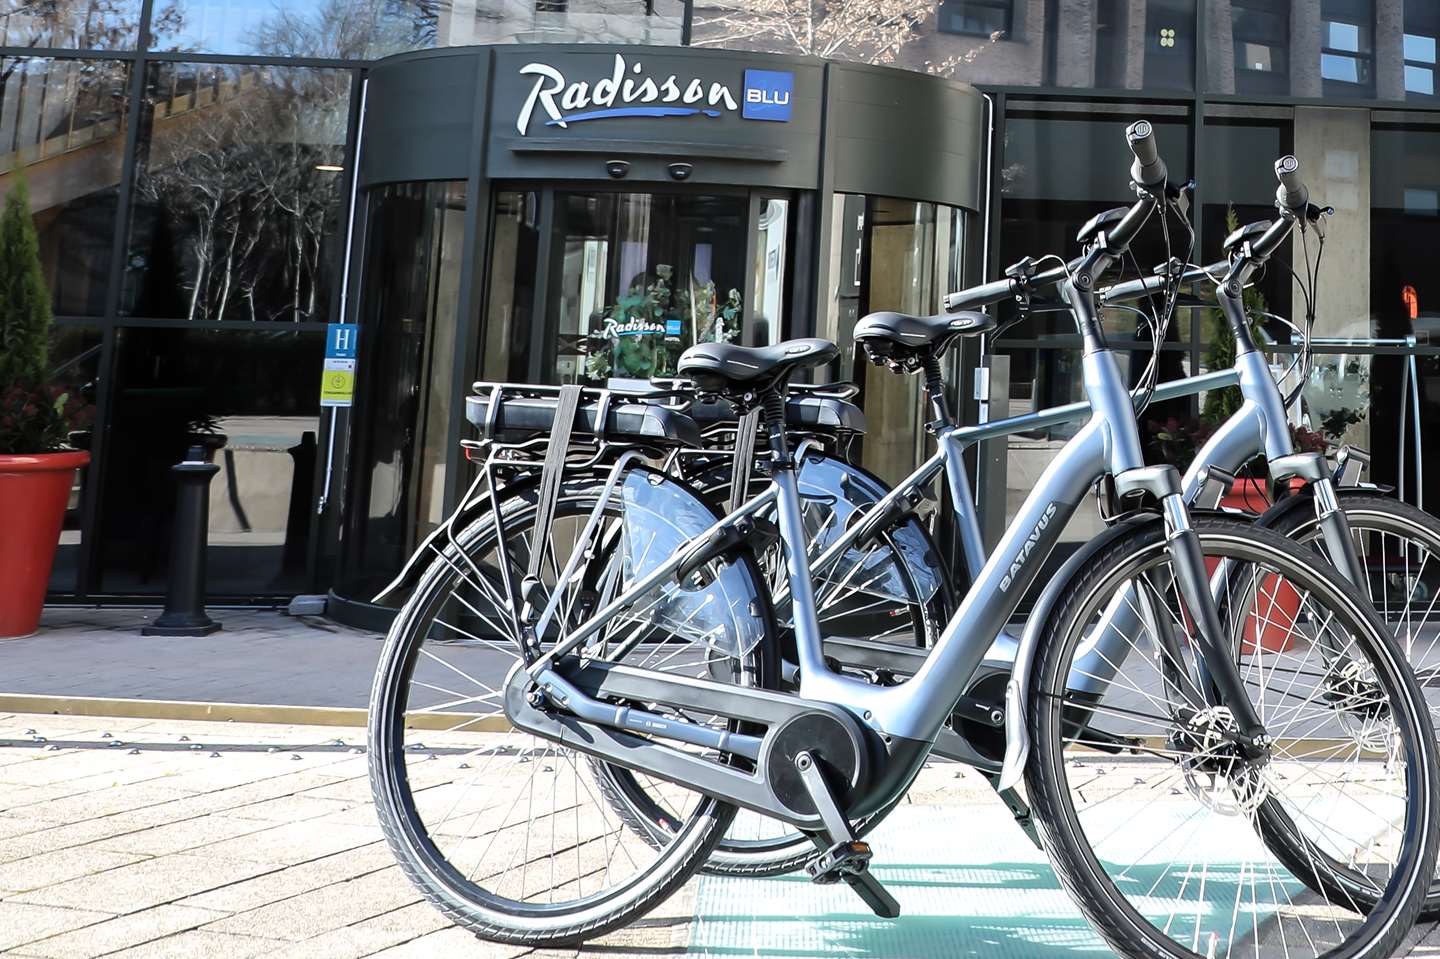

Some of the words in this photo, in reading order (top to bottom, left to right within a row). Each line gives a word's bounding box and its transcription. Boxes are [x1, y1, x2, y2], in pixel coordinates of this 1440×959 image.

[516, 53, 738, 136] Radisson
[746, 88, 790, 105] BLU
[335, 328, 351, 350] H
[603, 316, 666, 339] Radisson
[999, 502, 1057, 593] BATAVUS
